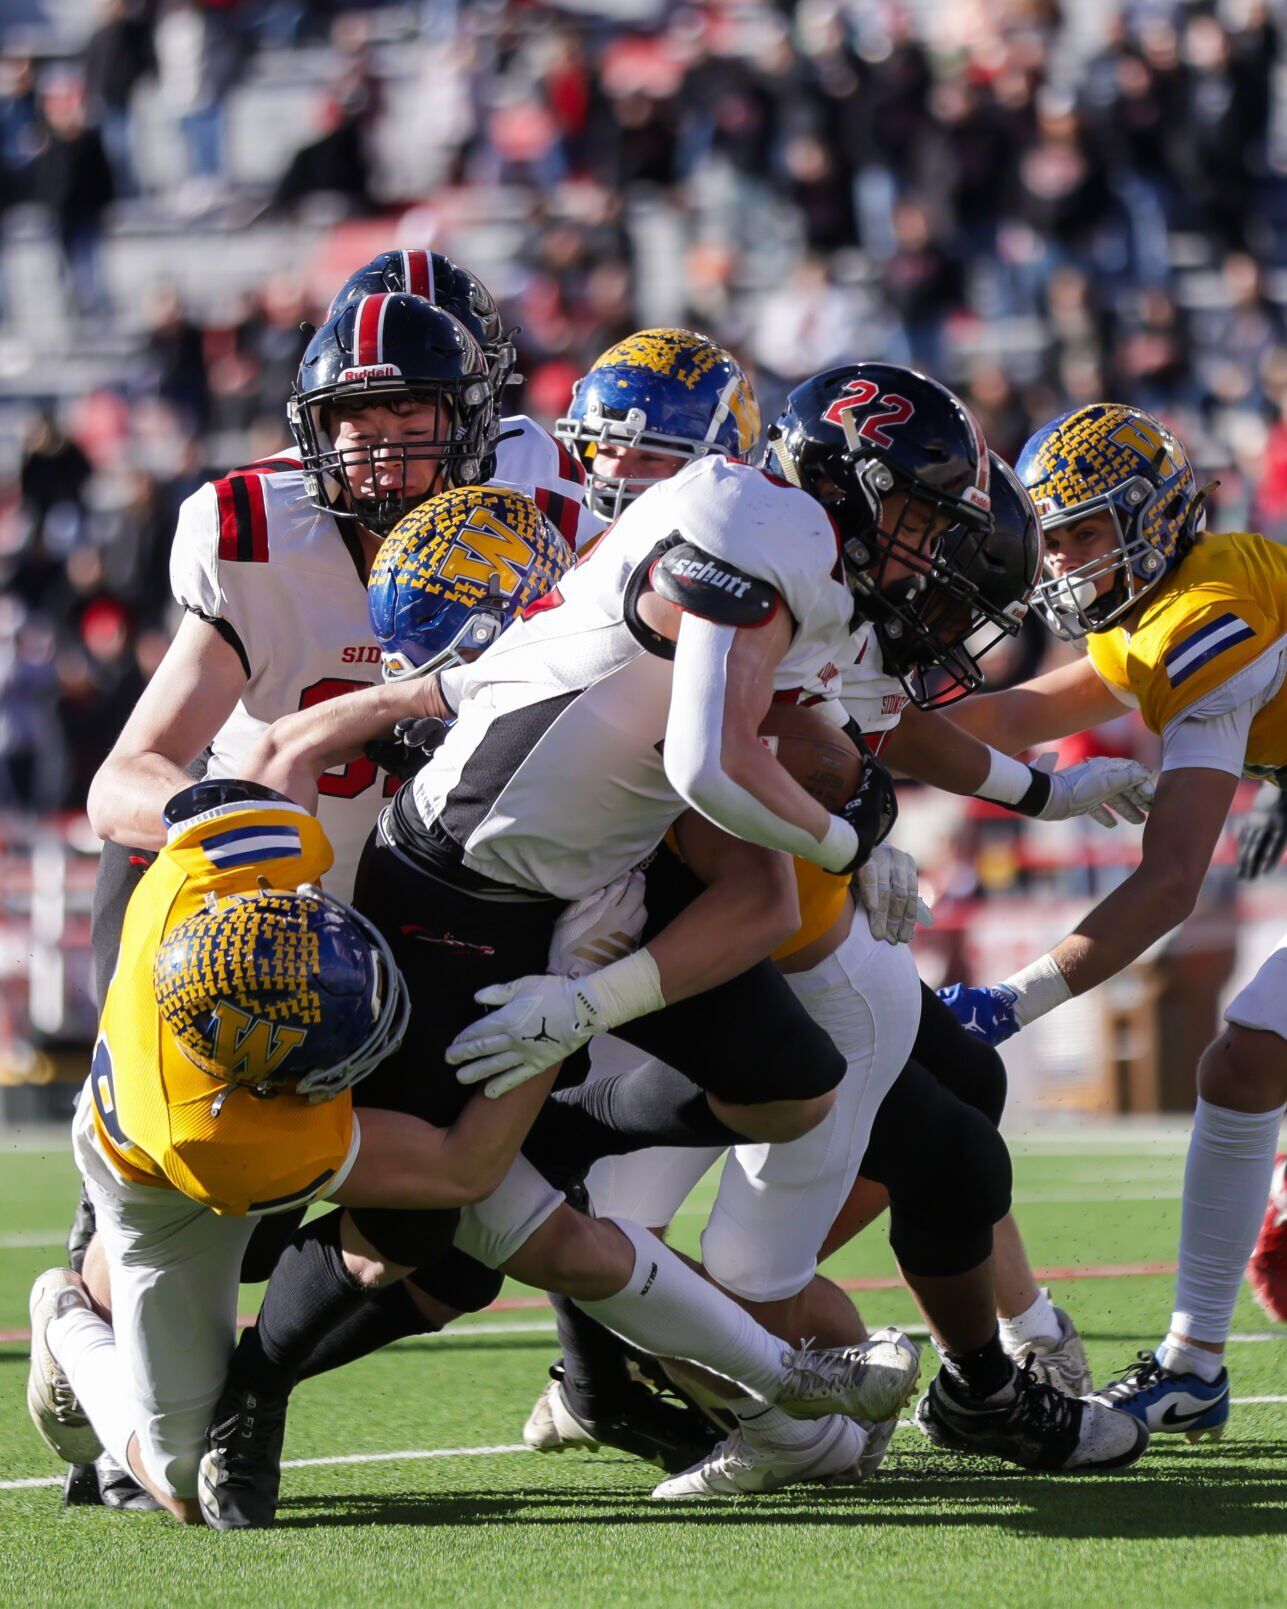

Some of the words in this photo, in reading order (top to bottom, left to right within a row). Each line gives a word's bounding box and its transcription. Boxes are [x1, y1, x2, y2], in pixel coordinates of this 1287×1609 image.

[824, 380, 915, 449] 22
[437, 506, 536, 597] W
[671, 559, 752, 599] schutt
[341, 646, 384, 664] SID
[211, 999, 308, 1085] W
